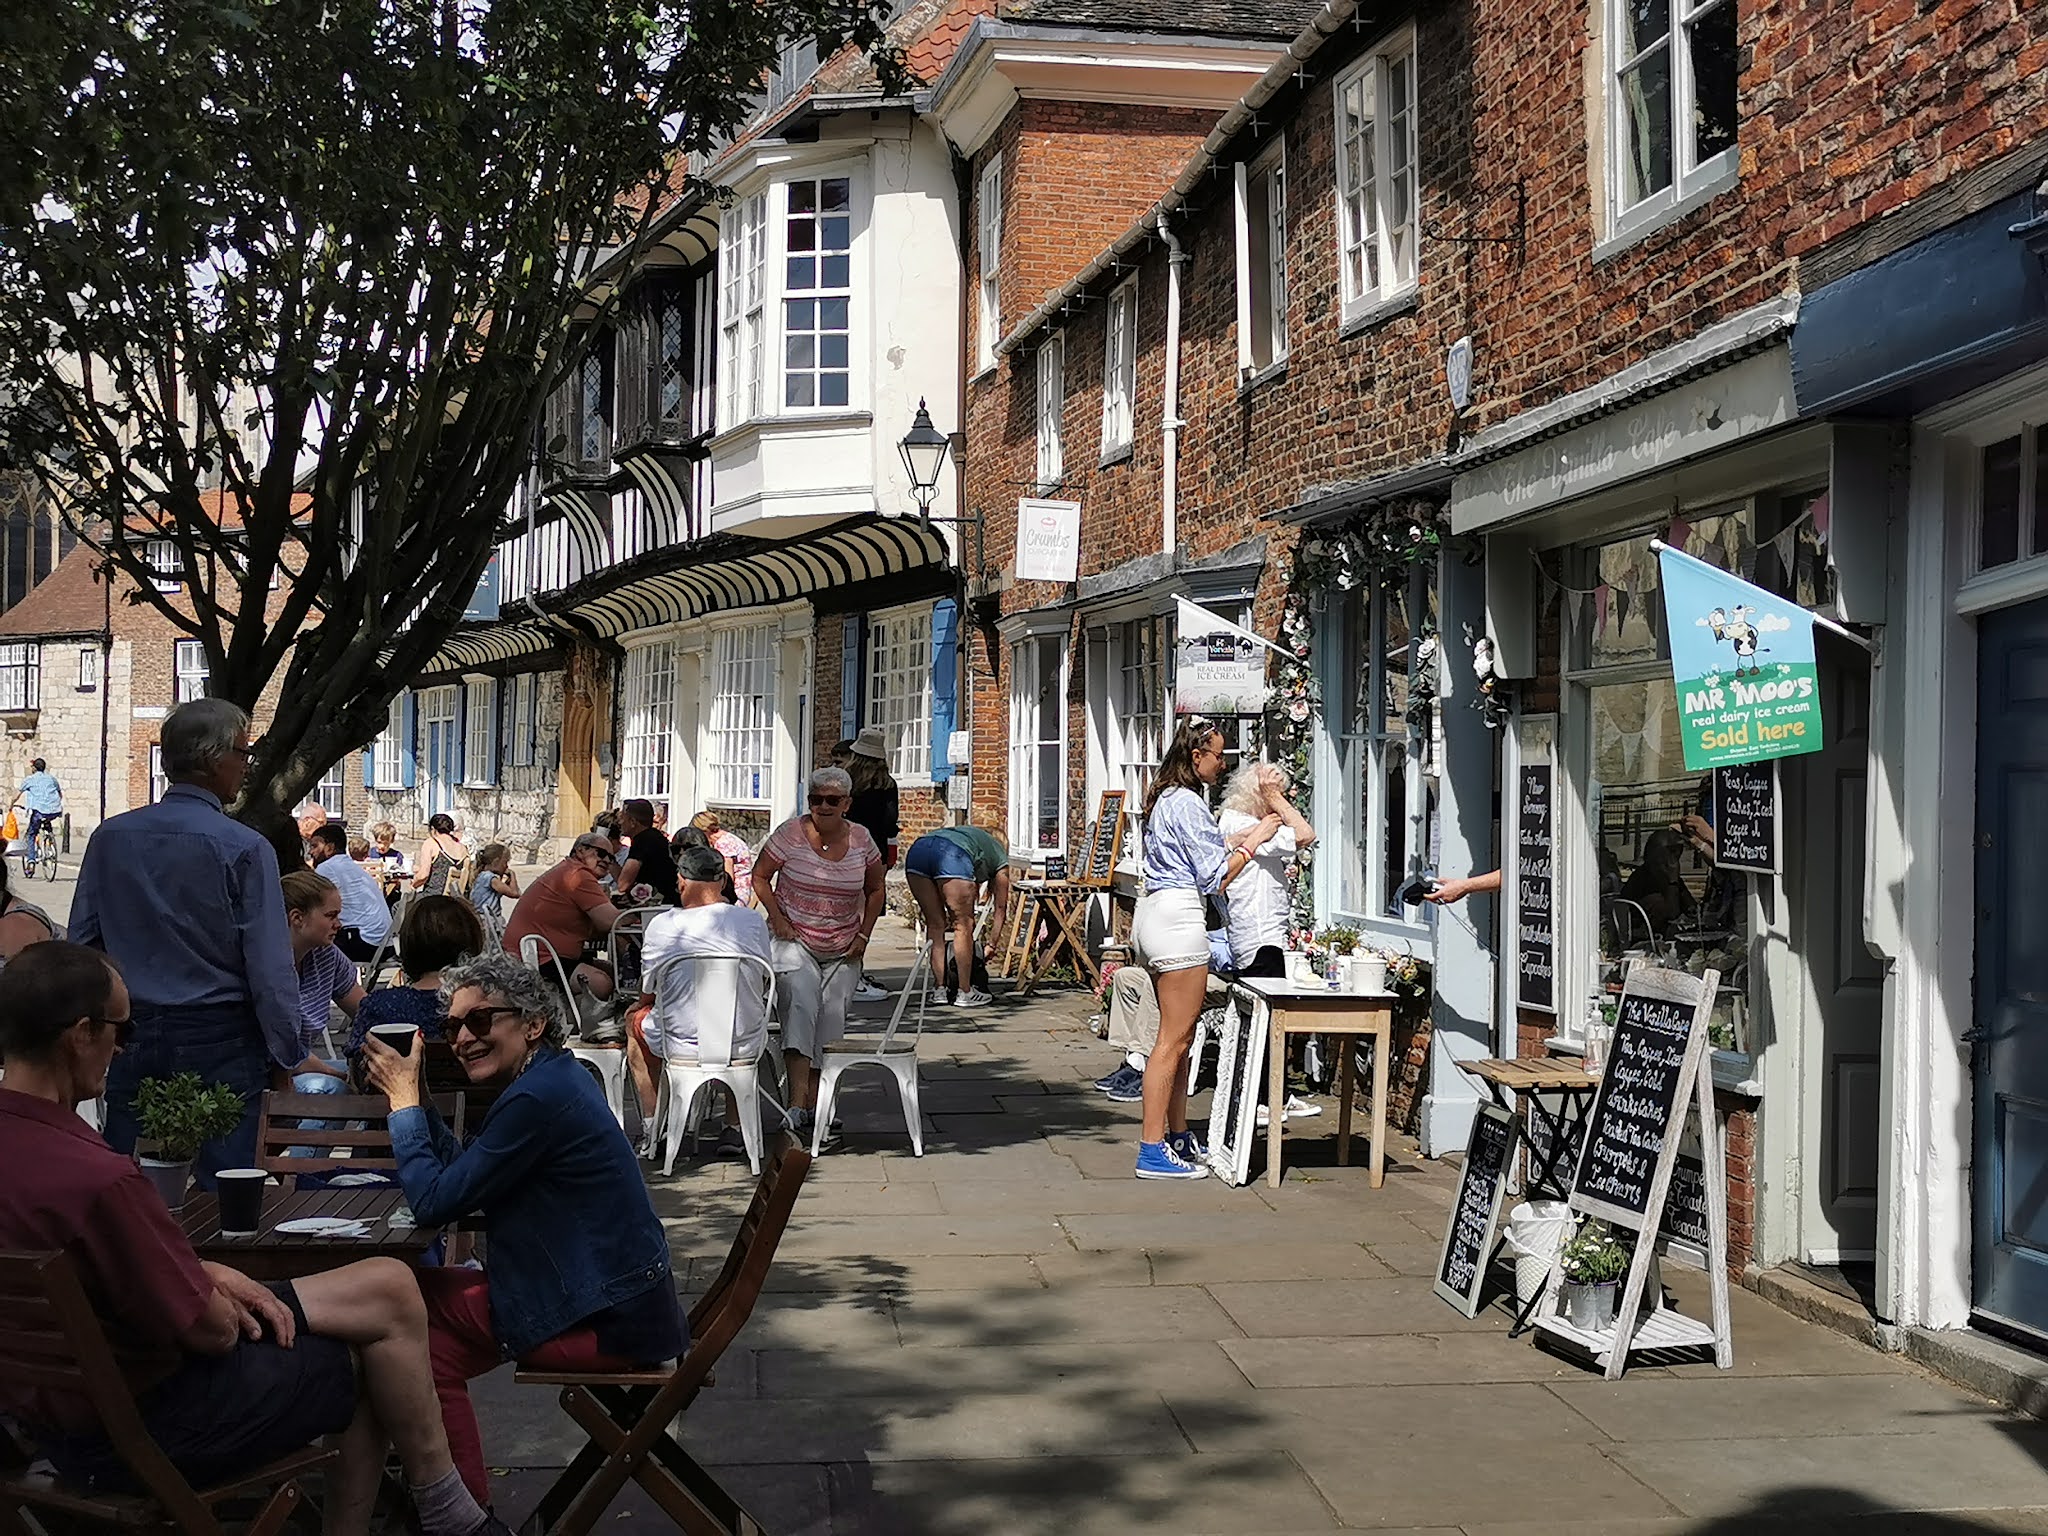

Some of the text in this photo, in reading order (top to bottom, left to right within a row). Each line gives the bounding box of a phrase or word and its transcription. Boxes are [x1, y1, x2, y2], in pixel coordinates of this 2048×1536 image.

[1503, 464, 1537, 505] The
[1026, 528, 1071, 549] Crumbs
[1208, 644, 1236, 654] Yorvale
[1196, 665, 1238, 673] REAL DAIRY
[1196, 672, 1246, 680] ICE CREAM
[1685, 676, 1813, 714] MR MOO'S
[1692, 701, 1811, 727] real dairy ice cream
[1700, 723, 1749, 750] Sold
[1757, 721, 1806, 742] here
[1625, 1000, 1642, 1021] The
